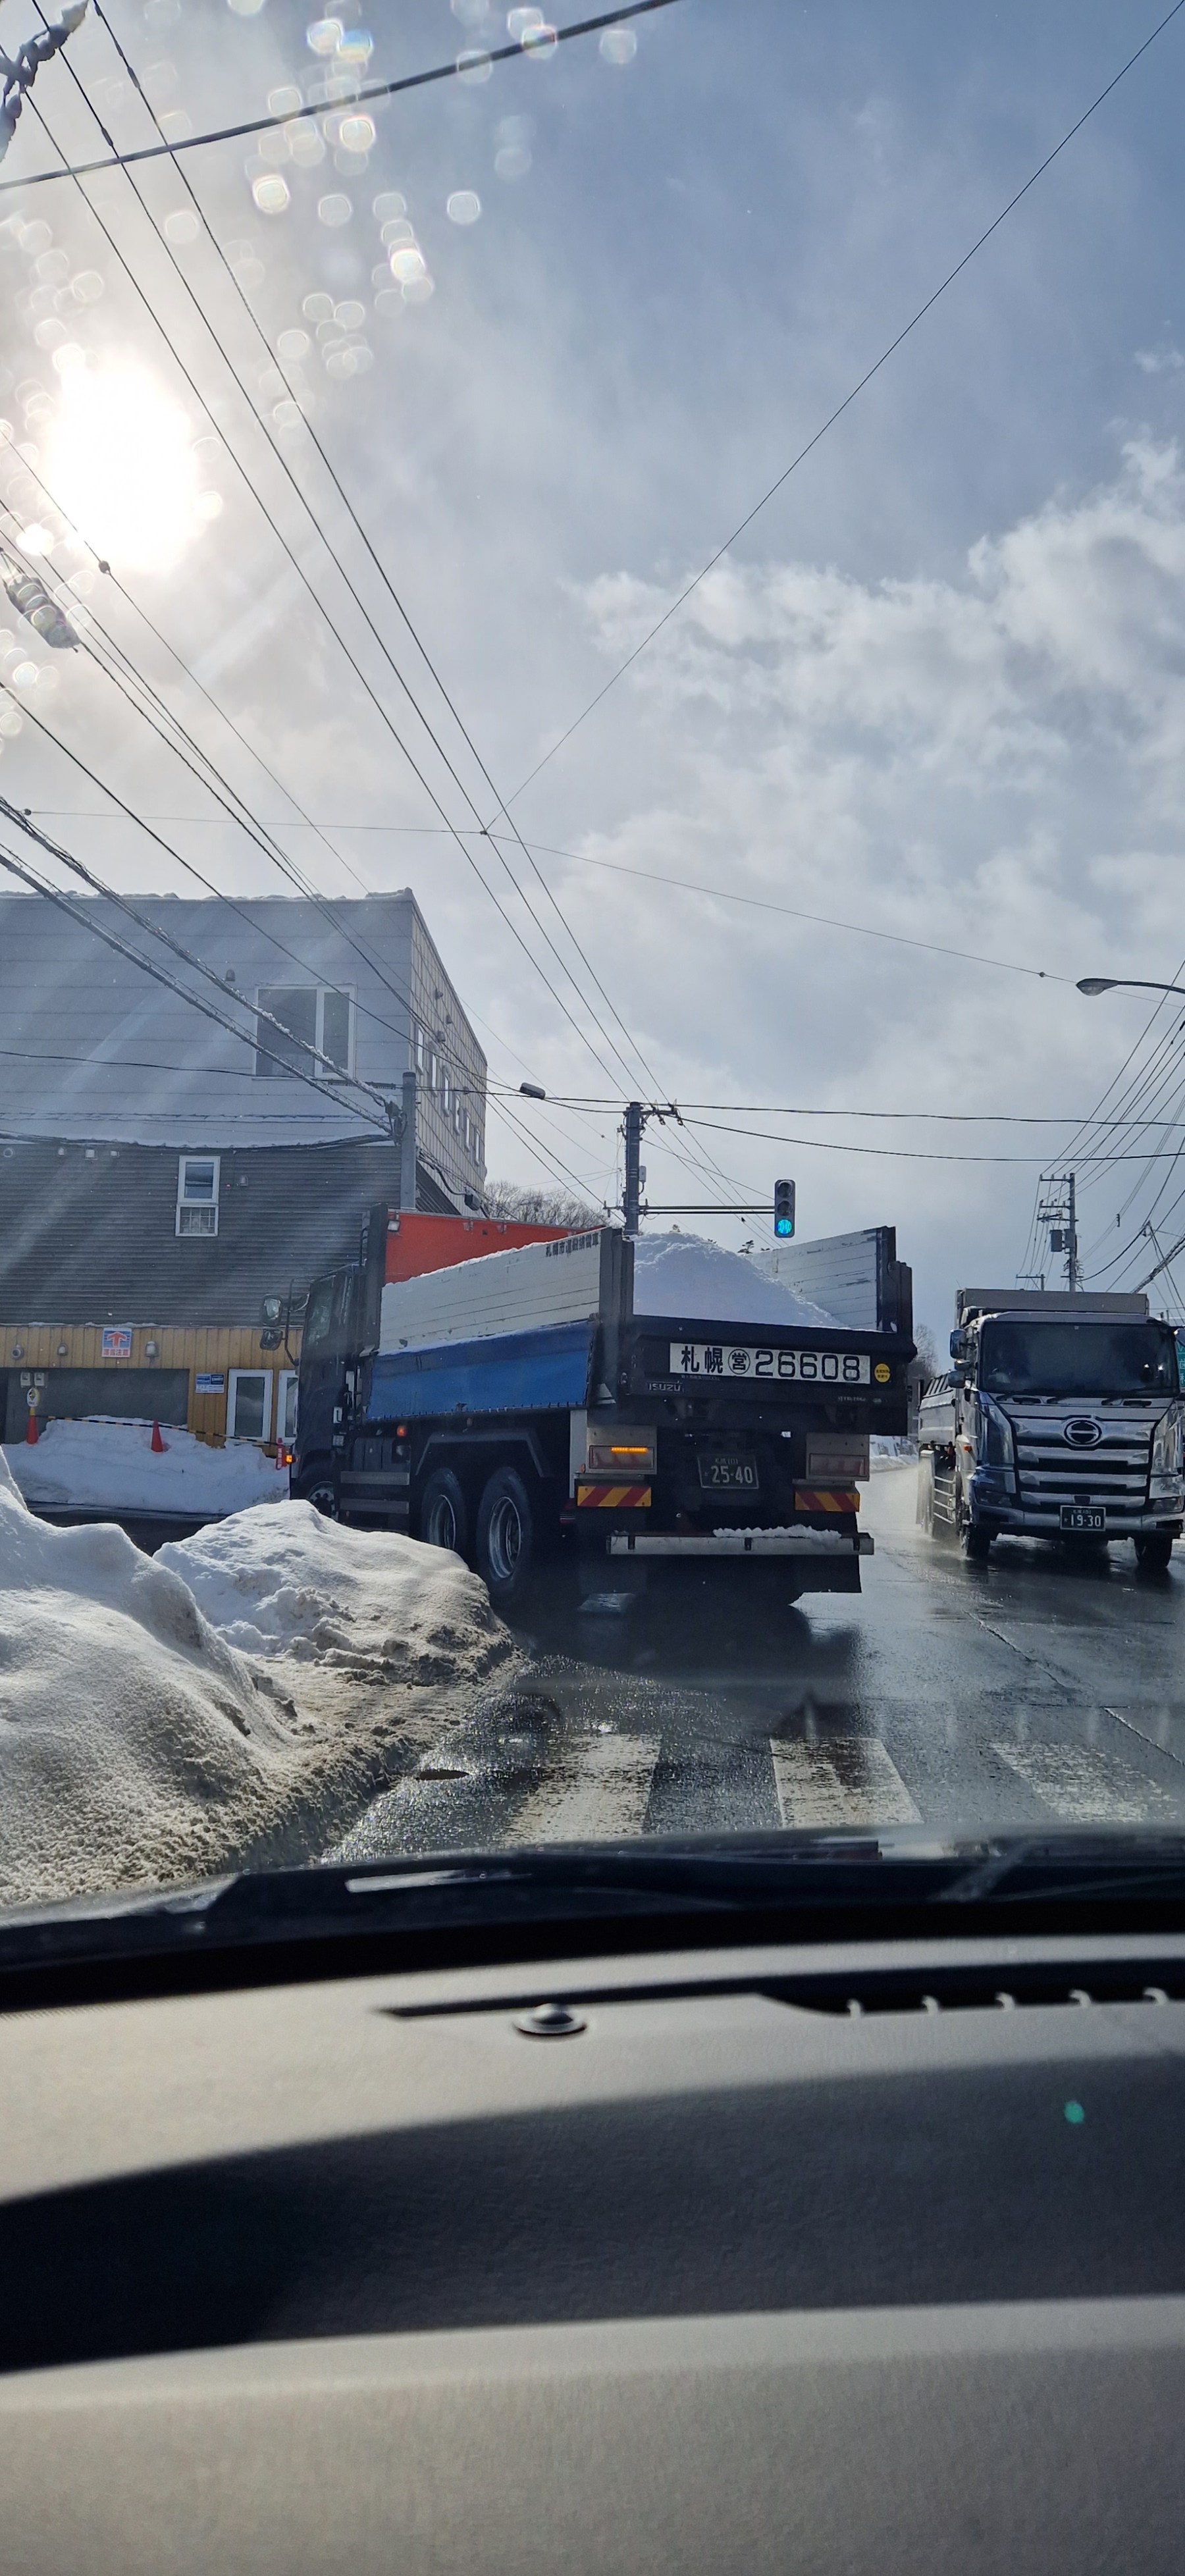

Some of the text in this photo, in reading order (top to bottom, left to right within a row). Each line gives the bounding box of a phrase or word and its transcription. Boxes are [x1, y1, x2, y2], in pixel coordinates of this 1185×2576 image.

[648, 1383, 681, 1392] ISUZU
[711, 1465, 753, 1484] 25-40
[1071, 1514, 1101, 1527] 19-30
